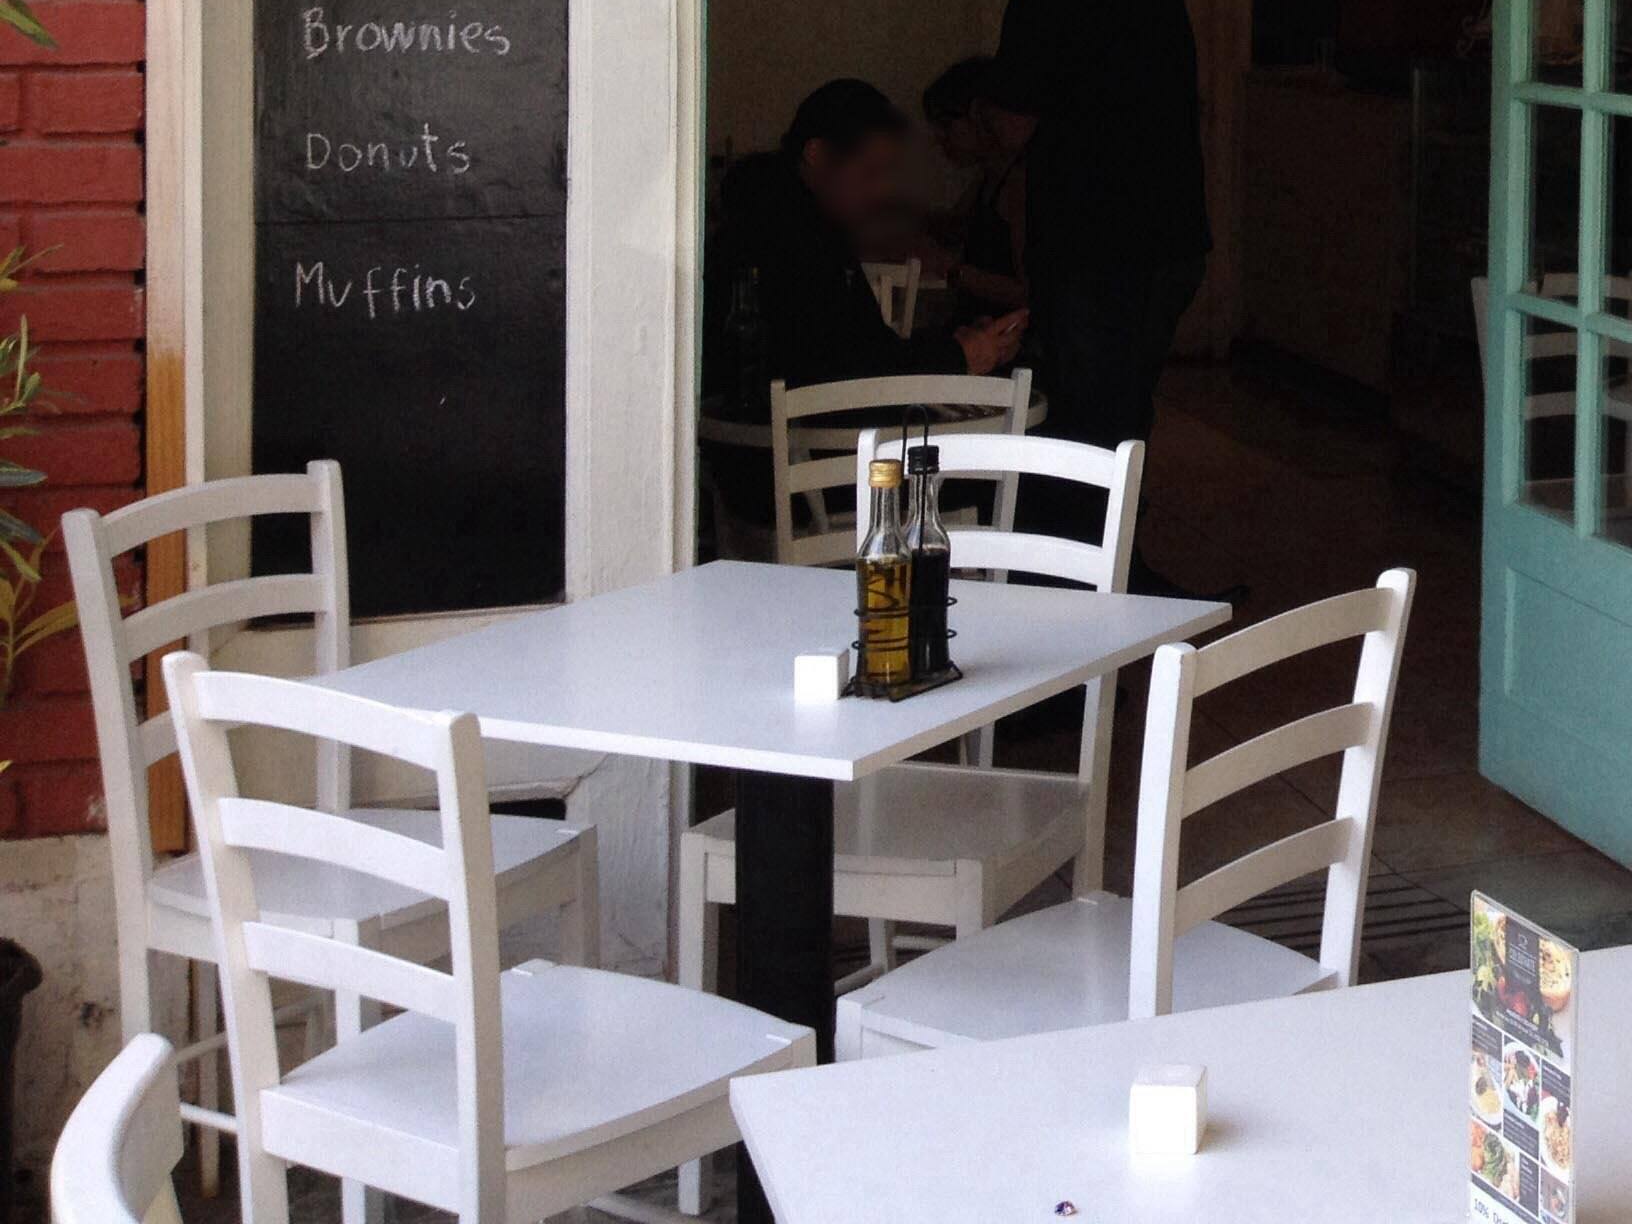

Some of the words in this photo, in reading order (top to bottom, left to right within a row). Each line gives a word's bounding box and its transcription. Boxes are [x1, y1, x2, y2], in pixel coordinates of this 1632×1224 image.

[303, 6, 511, 60] Brownies
[307, 123, 471, 175] Donuts
[295, 262, 477, 319] Muffins
